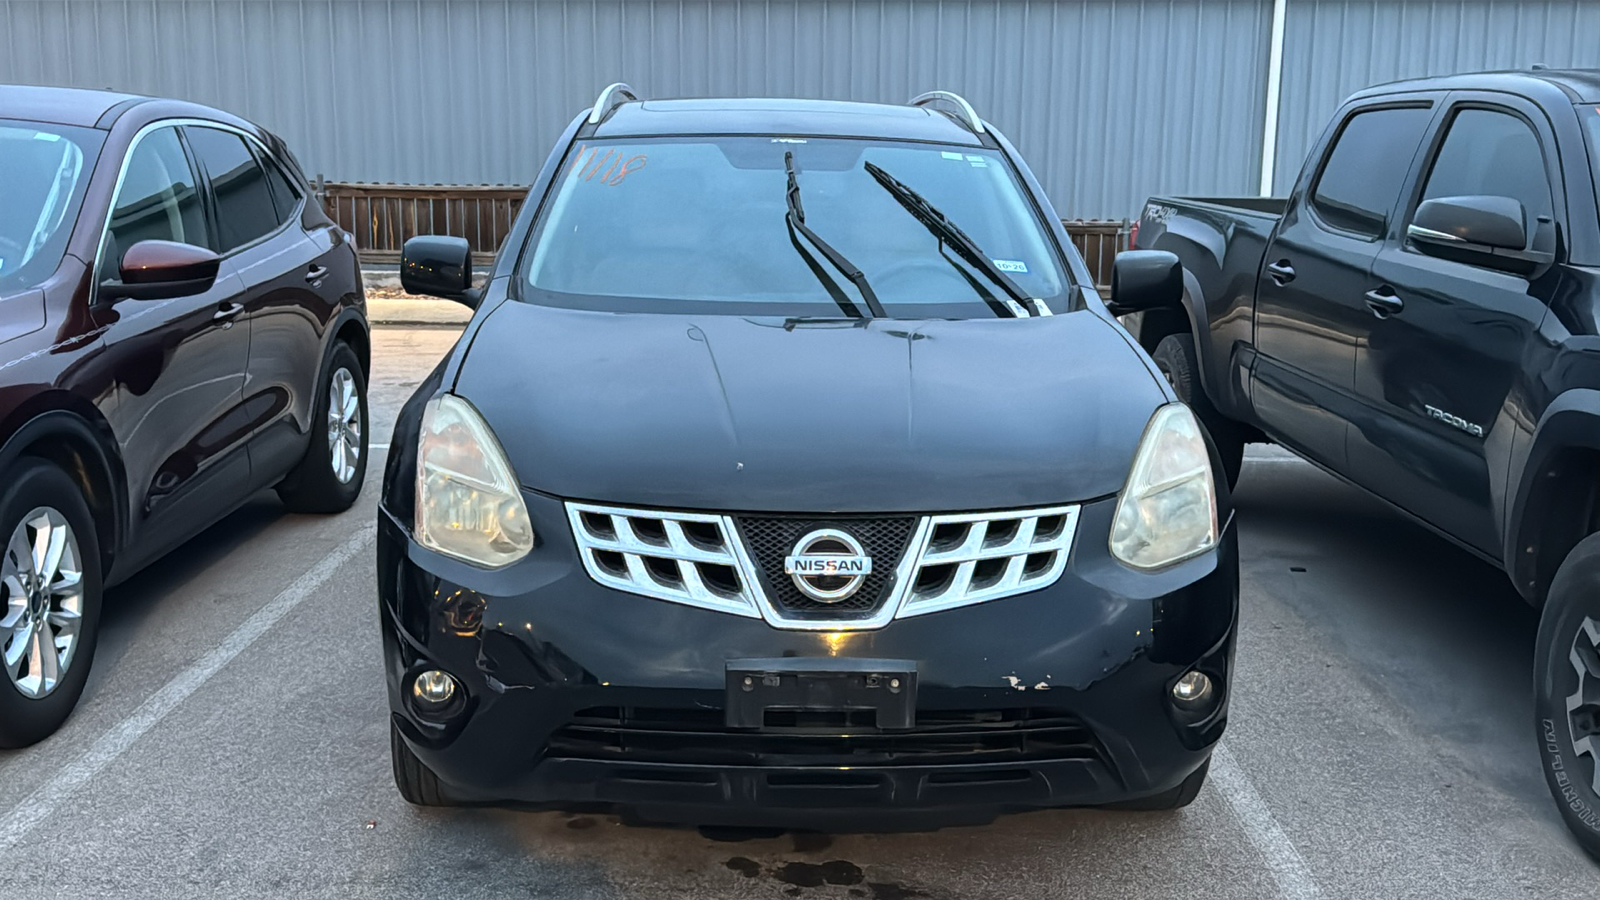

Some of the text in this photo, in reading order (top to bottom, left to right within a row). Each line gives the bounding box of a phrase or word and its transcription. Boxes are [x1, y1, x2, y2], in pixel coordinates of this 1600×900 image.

[1425, 404, 1484, 437] TACOMA
[794, 560, 863, 571] NISSAN
[1542, 718, 1600, 832] MICHELIN
